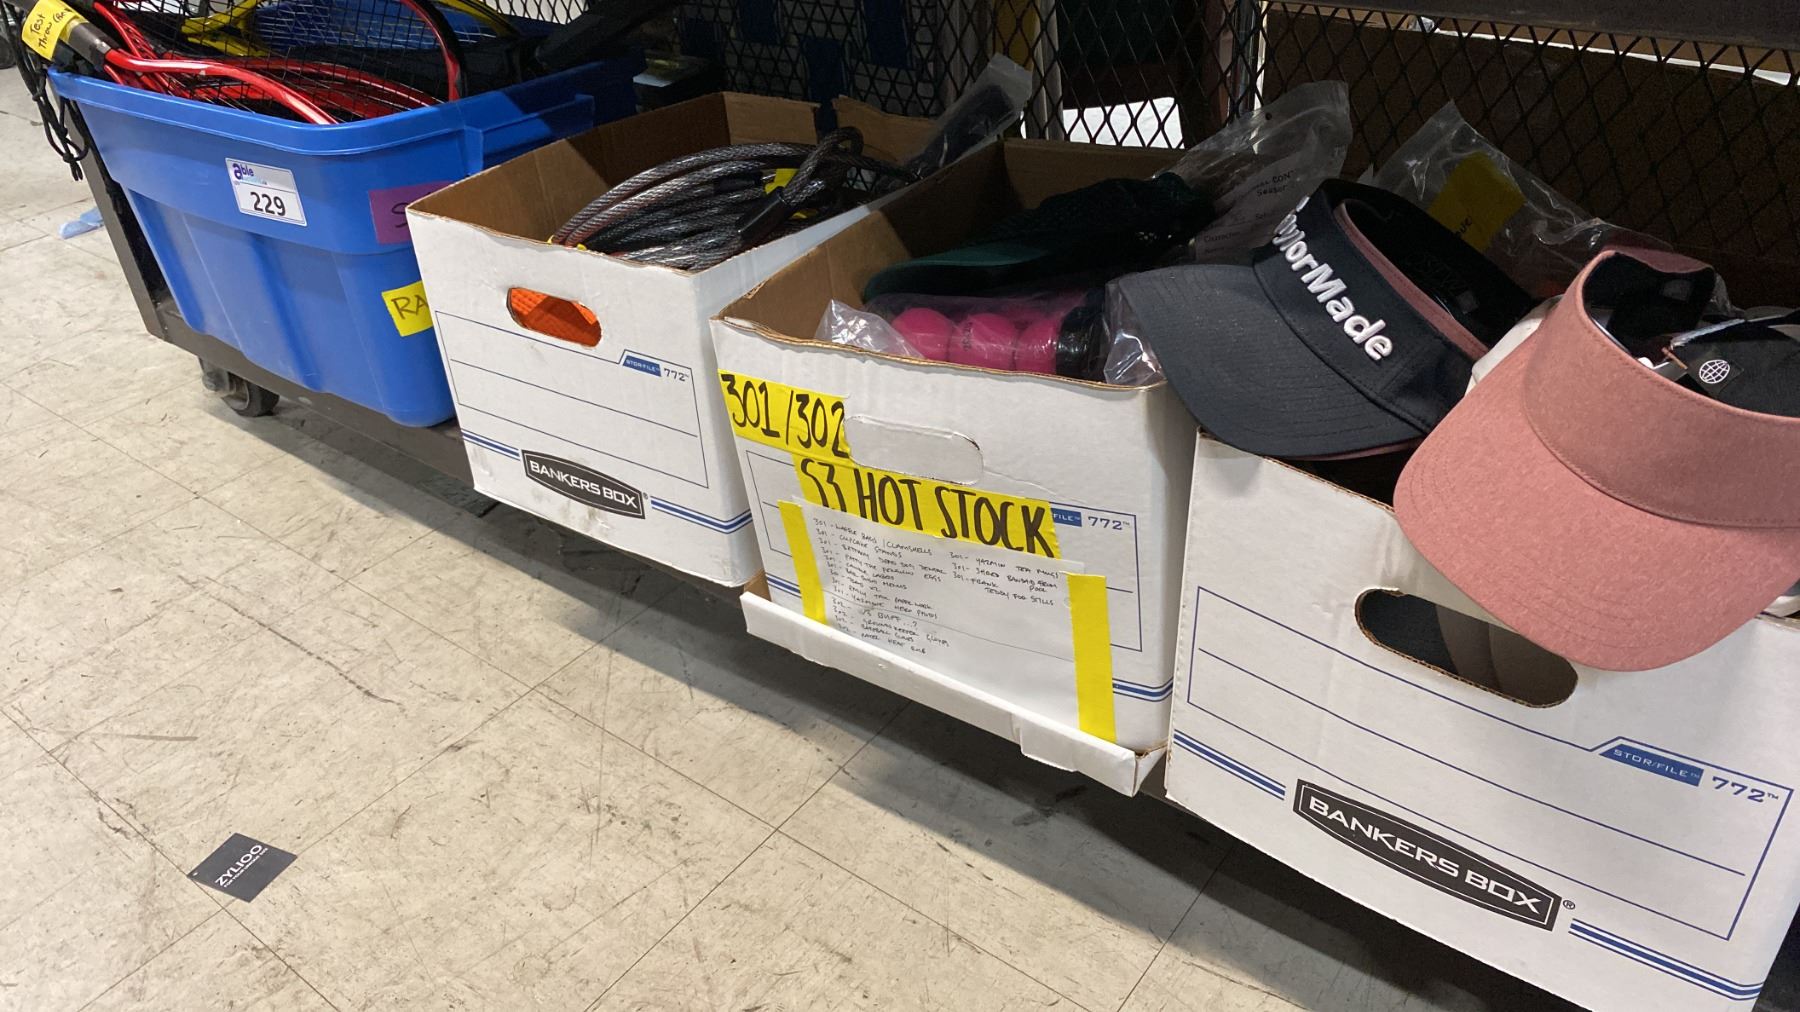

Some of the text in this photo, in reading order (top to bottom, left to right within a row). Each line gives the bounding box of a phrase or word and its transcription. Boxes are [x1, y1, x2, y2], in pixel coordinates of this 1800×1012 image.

[30, 14, 46, 35] Test
[38, 22, 53, 49] Throw
[250, 191, 286, 217] 229
[529, 460, 638, 509] BANKERS BOX
[854, 468, 925, 531] HOT
[935, 486, 1054, 558] STOCK
[215, 844, 263, 887] ZYLIOO
[1309, 796, 1542, 915] BANKERS BOX
